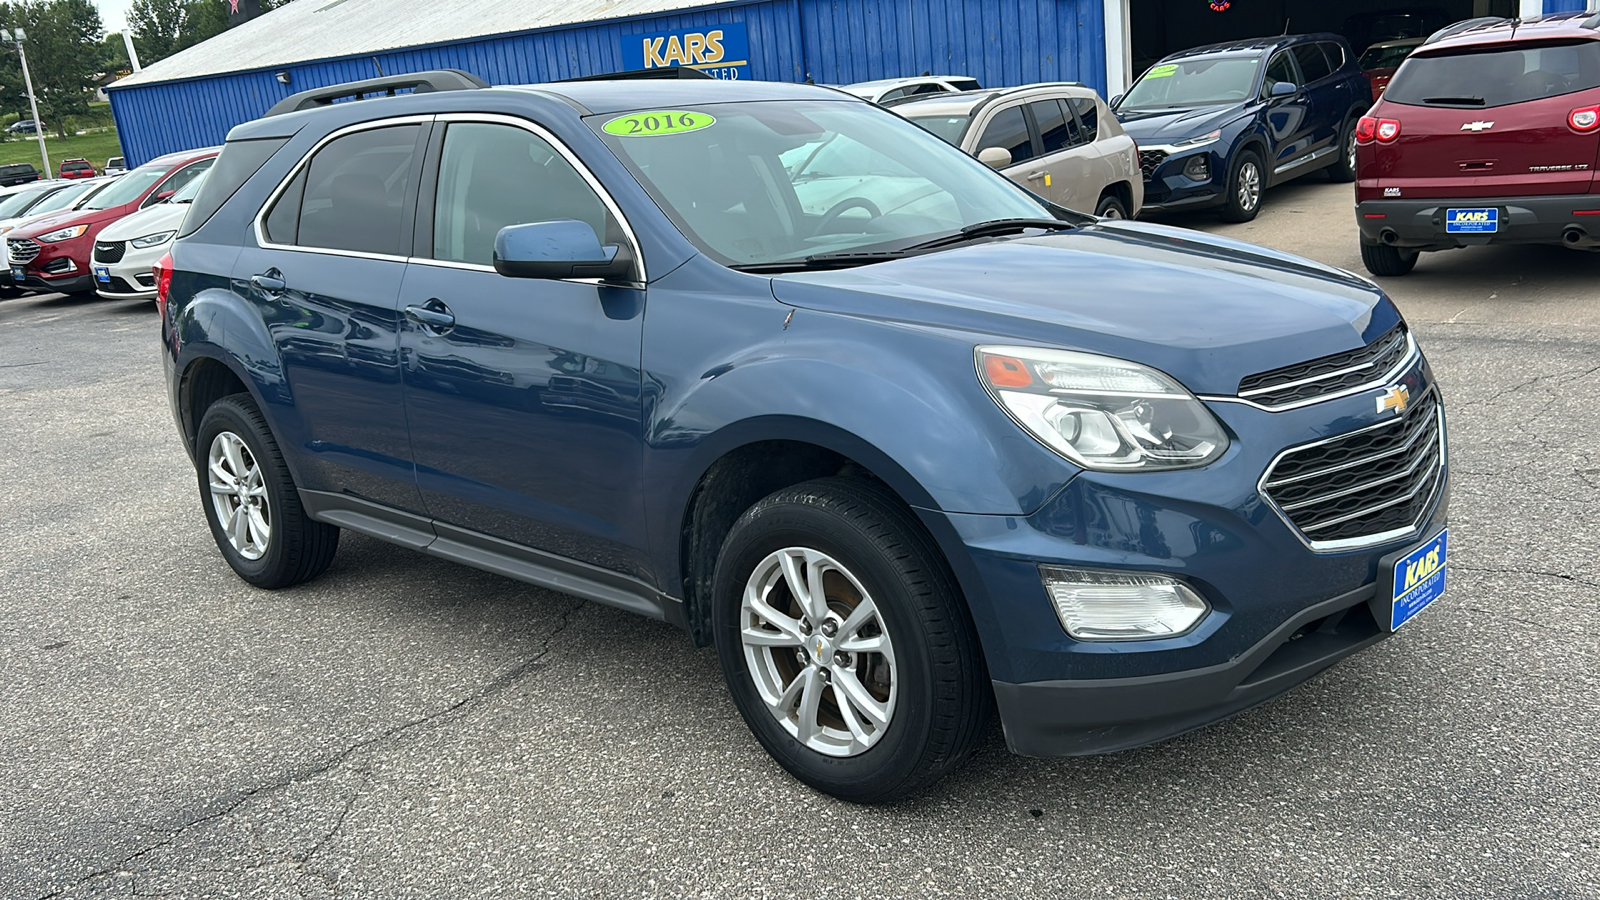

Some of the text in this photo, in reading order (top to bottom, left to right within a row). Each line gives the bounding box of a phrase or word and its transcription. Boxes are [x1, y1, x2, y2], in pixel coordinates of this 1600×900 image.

[643, 30, 725, 68] KARS
[624, 112, 695, 134] 2016
[1529, 164, 1572, 172] TRAVERSE
[1456, 211, 1489, 221] KARS
[1403, 544, 1440, 591] KARS
[1400, 571, 1441, 608] INCORPORATED
